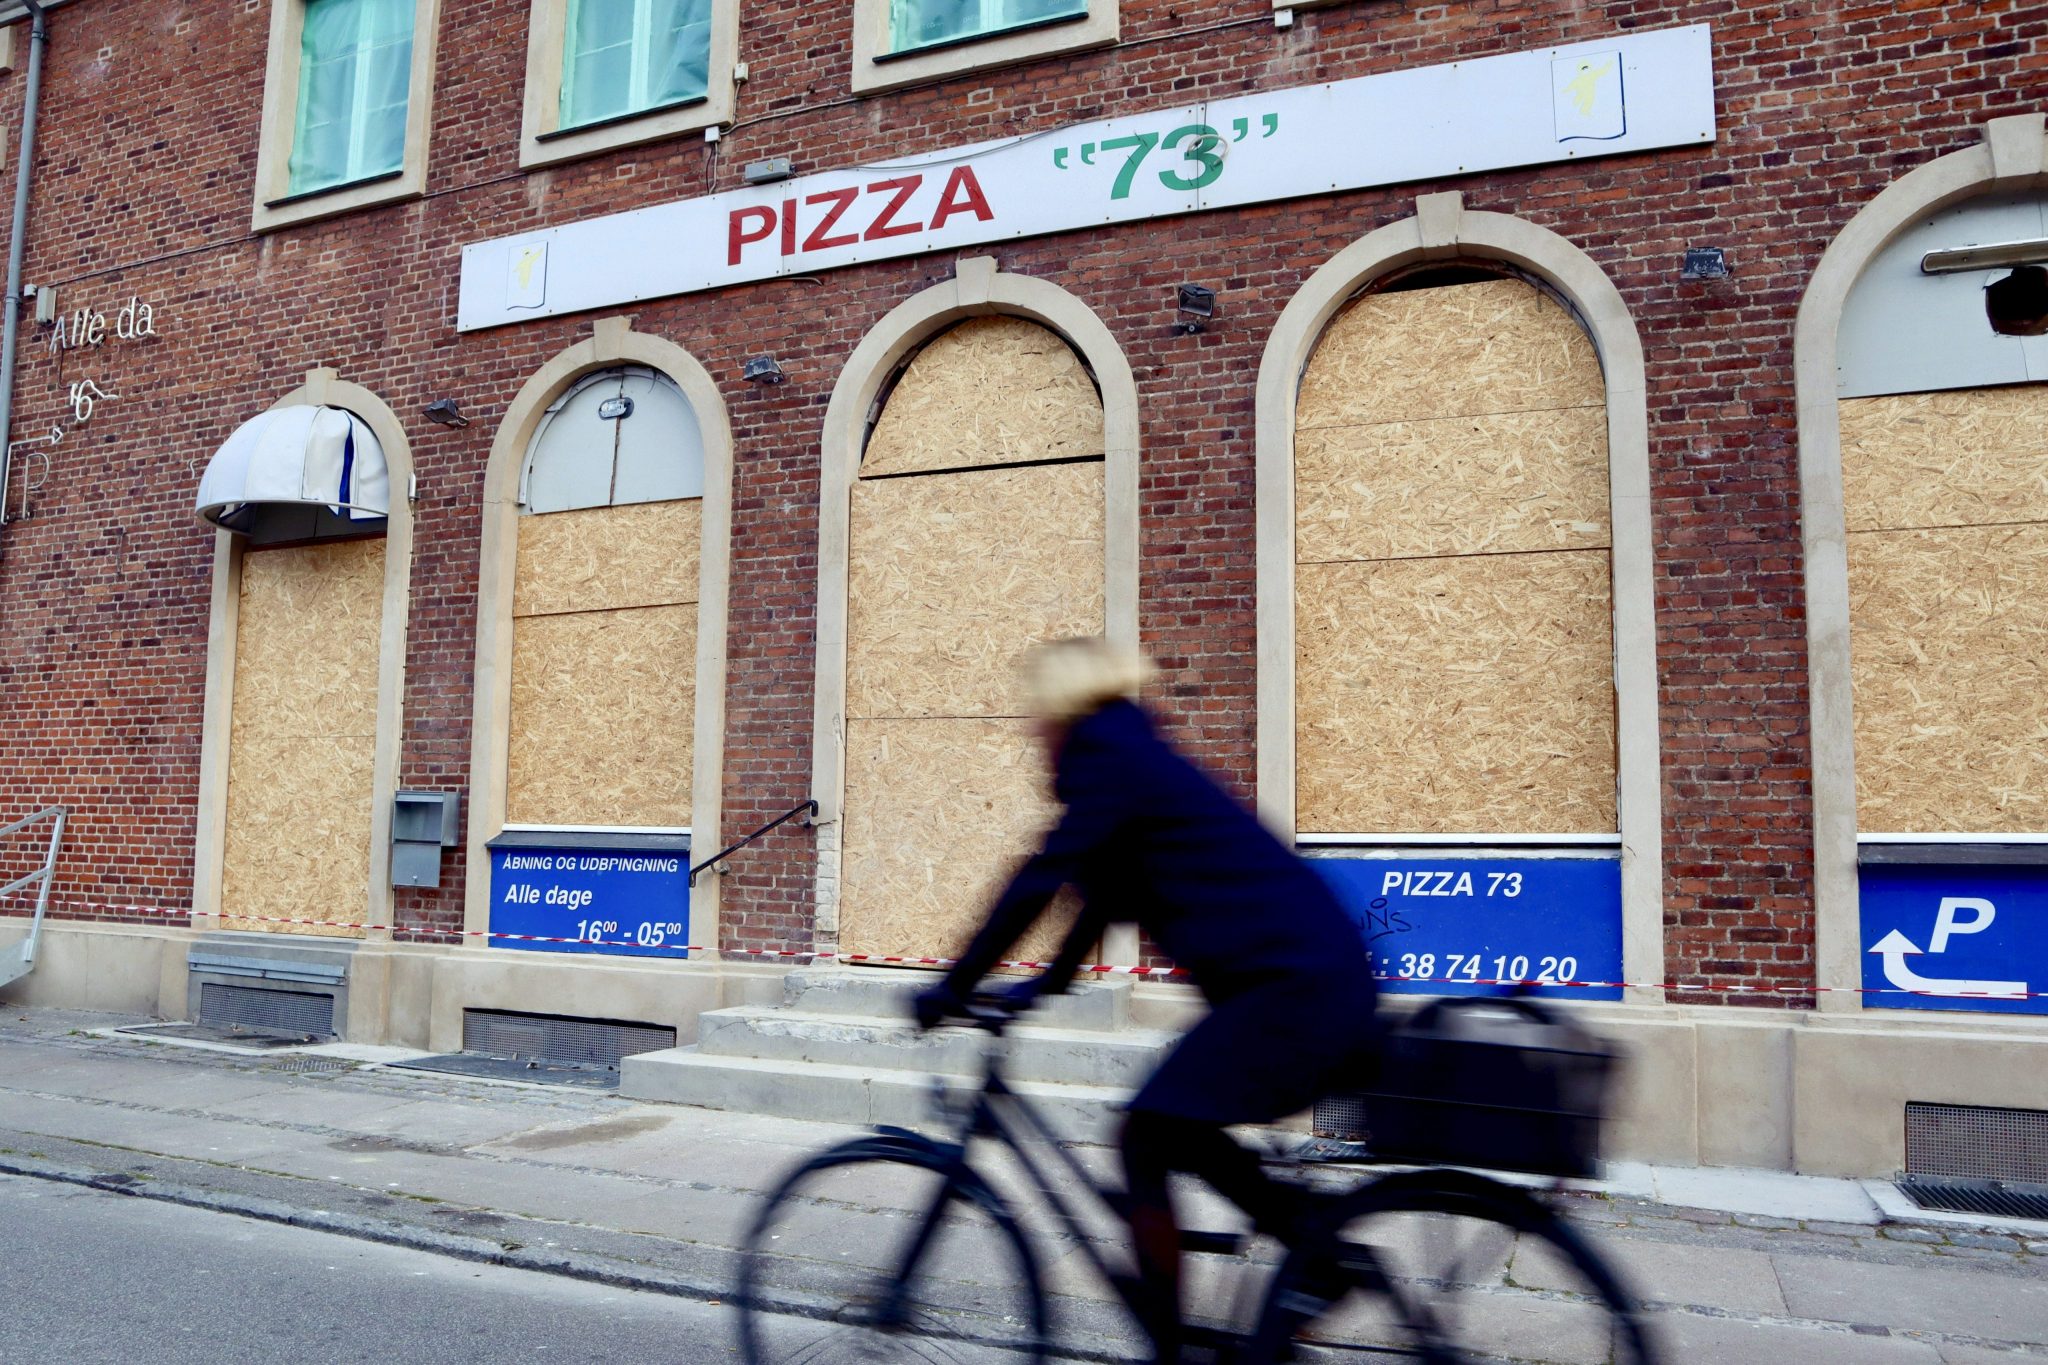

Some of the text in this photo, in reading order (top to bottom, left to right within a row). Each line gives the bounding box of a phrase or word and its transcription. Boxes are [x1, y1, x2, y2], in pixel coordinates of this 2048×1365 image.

[727, 164, 995, 267] PIZZA
[49, 296, 155, 353] Alle da
[502, 853, 552, 870] ÅBNING
[556, 857, 576, 871] OG
[504, 884, 593, 910] Alle dage
[1381, 871, 1523, 898] PIZZA 73
[1928, 896, 1996, 953] P
[1398, 953, 1436, 978] 38
[1445, 954, 1481, 979] 74
[1492, 955, 1529, 981] 10
[1537, 956, 1578, 982] 20
